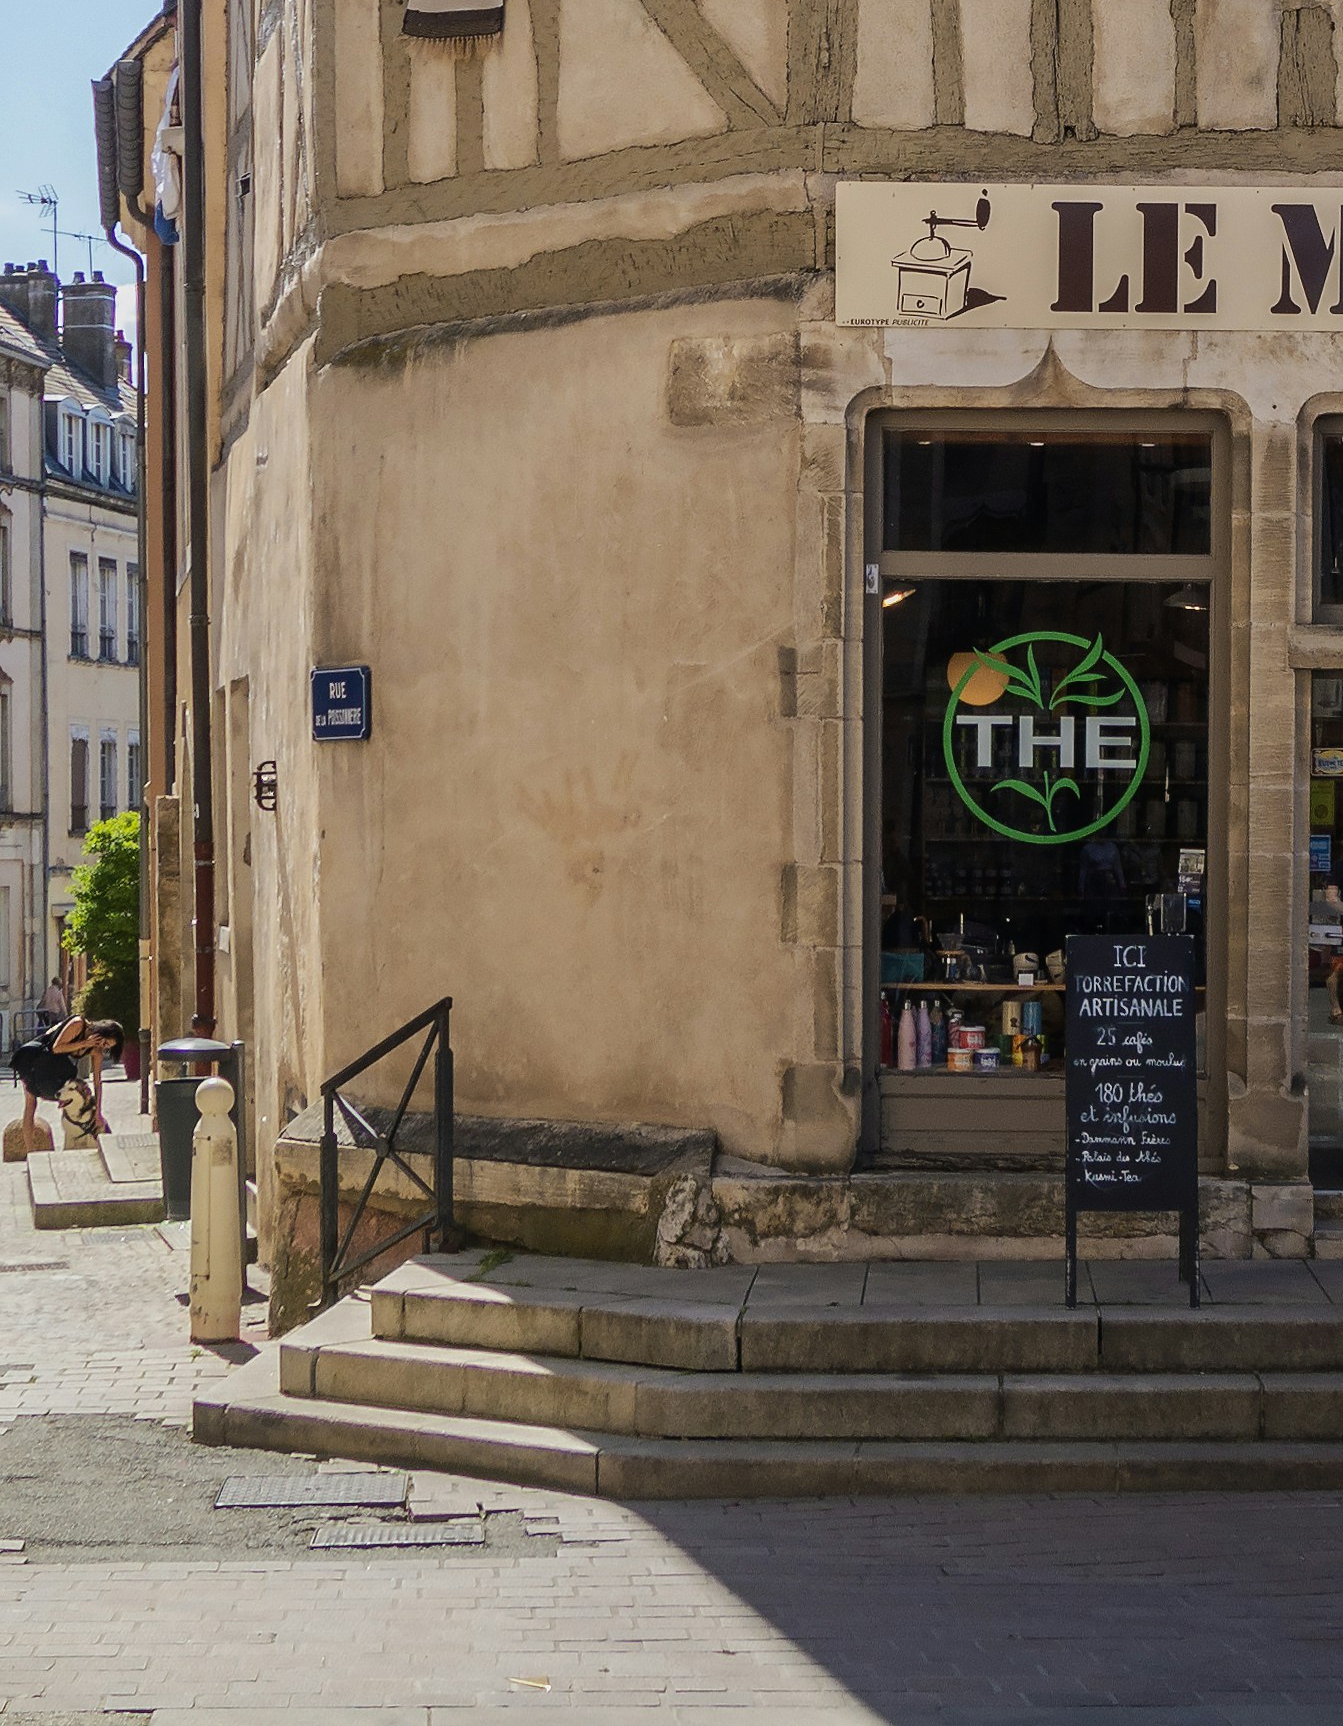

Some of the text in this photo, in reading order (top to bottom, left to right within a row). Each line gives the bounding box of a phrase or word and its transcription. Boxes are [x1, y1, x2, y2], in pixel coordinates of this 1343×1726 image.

[1050, 202, 1217, 313] LE
[329, 681, 347, 699] RUE
[956, 715, 1137, 769] THE
[1113, 945, 1146, 967] ICI
[1079, 996, 1184, 1017] ARTISANALE
[1096, 1027, 1117, 1045] 25
[1089, 1055, 1122, 1075] grains
[1125, 1059, 1141, 1067] ou
[1095, 1082, 1163, 1103] 180 thés
[1080, 1105, 1177, 1134] et infusions
